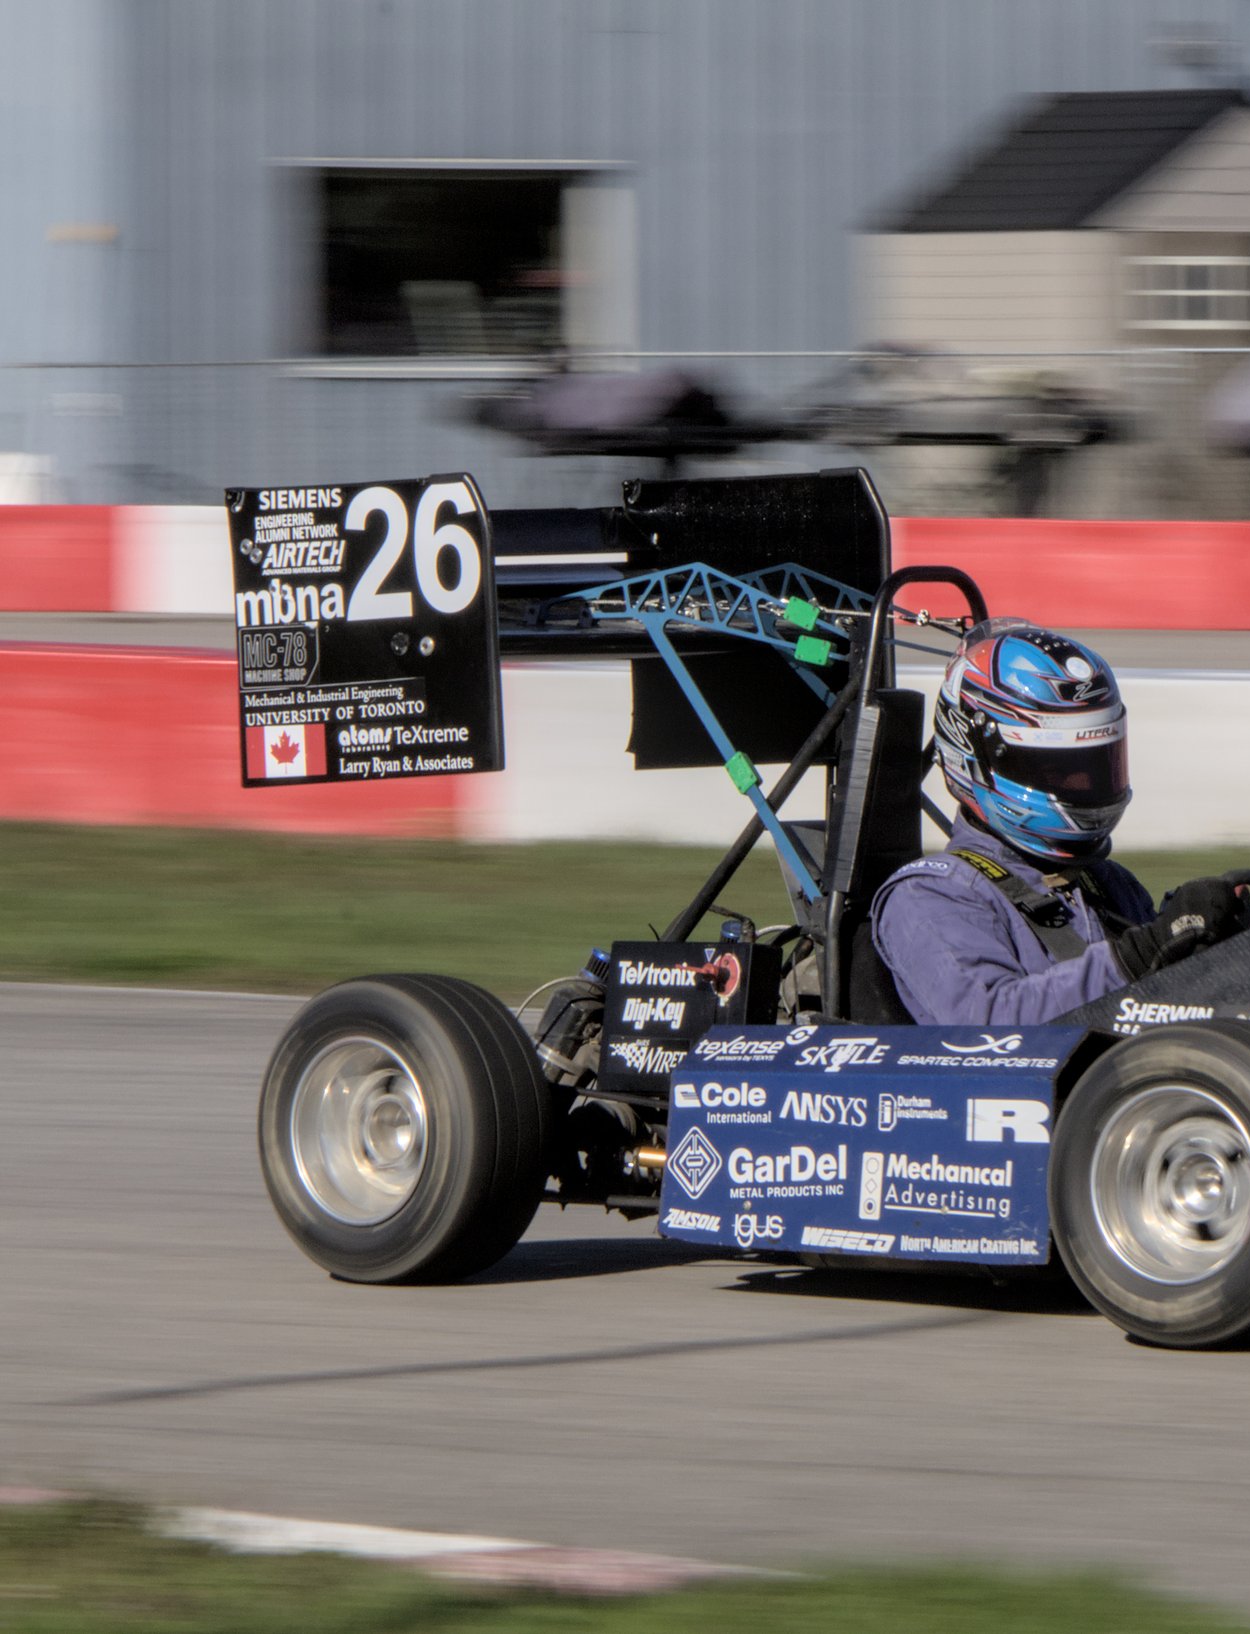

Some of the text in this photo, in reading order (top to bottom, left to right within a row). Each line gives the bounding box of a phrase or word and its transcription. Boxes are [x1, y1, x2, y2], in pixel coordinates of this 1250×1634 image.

[259, 487, 343, 511] SIEMENS
[254, 512, 315, 530] ENGINEERING
[255, 523, 339, 543] ALUMNI NETWORK
[262, 539, 347, 568] AIRTECH
[345, 481, 482, 622] 26
[236, 578, 345, 627] mbna
[243, 631, 307, 669] MC-78
[244, 667, 307, 684] MACHINE SHOP
[244, 684, 404, 708] Mechanical & Industrial Engineering
[245, 700, 425, 726] UNIVERSITY OF TORONTO
[338, 724, 470, 747] atoms TeXtreme
[339, 754, 474, 778] Larry Ryan & Associates
[621, 996, 687, 1030] Digi-Key
[1115, 997, 1215, 1024] SHERWIN
[694, 1035, 786, 1062] texense
[896, 1055, 1059, 1069] SPARTEC COMPOSITES
[701, 1082, 767, 1108] Cole
[897, 1094, 932, 1107] Durham
[706, 1110, 772, 1125] International
[779, 1090, 868, 1128] ANSYS
[728, 1144, 848, 1185] GarDel
[886, 1153, 1013, 1188] Mechanical
[729, 1184, 844, 1200] METAL PRODUCTS INC
[884, 1182, 1011, 1219] Advertising
[662, 1207, 721, 1233] AMSOIL
[731, 1213, 787, 1248] igus
[980, 1237, 1020, 1255] CRATING
